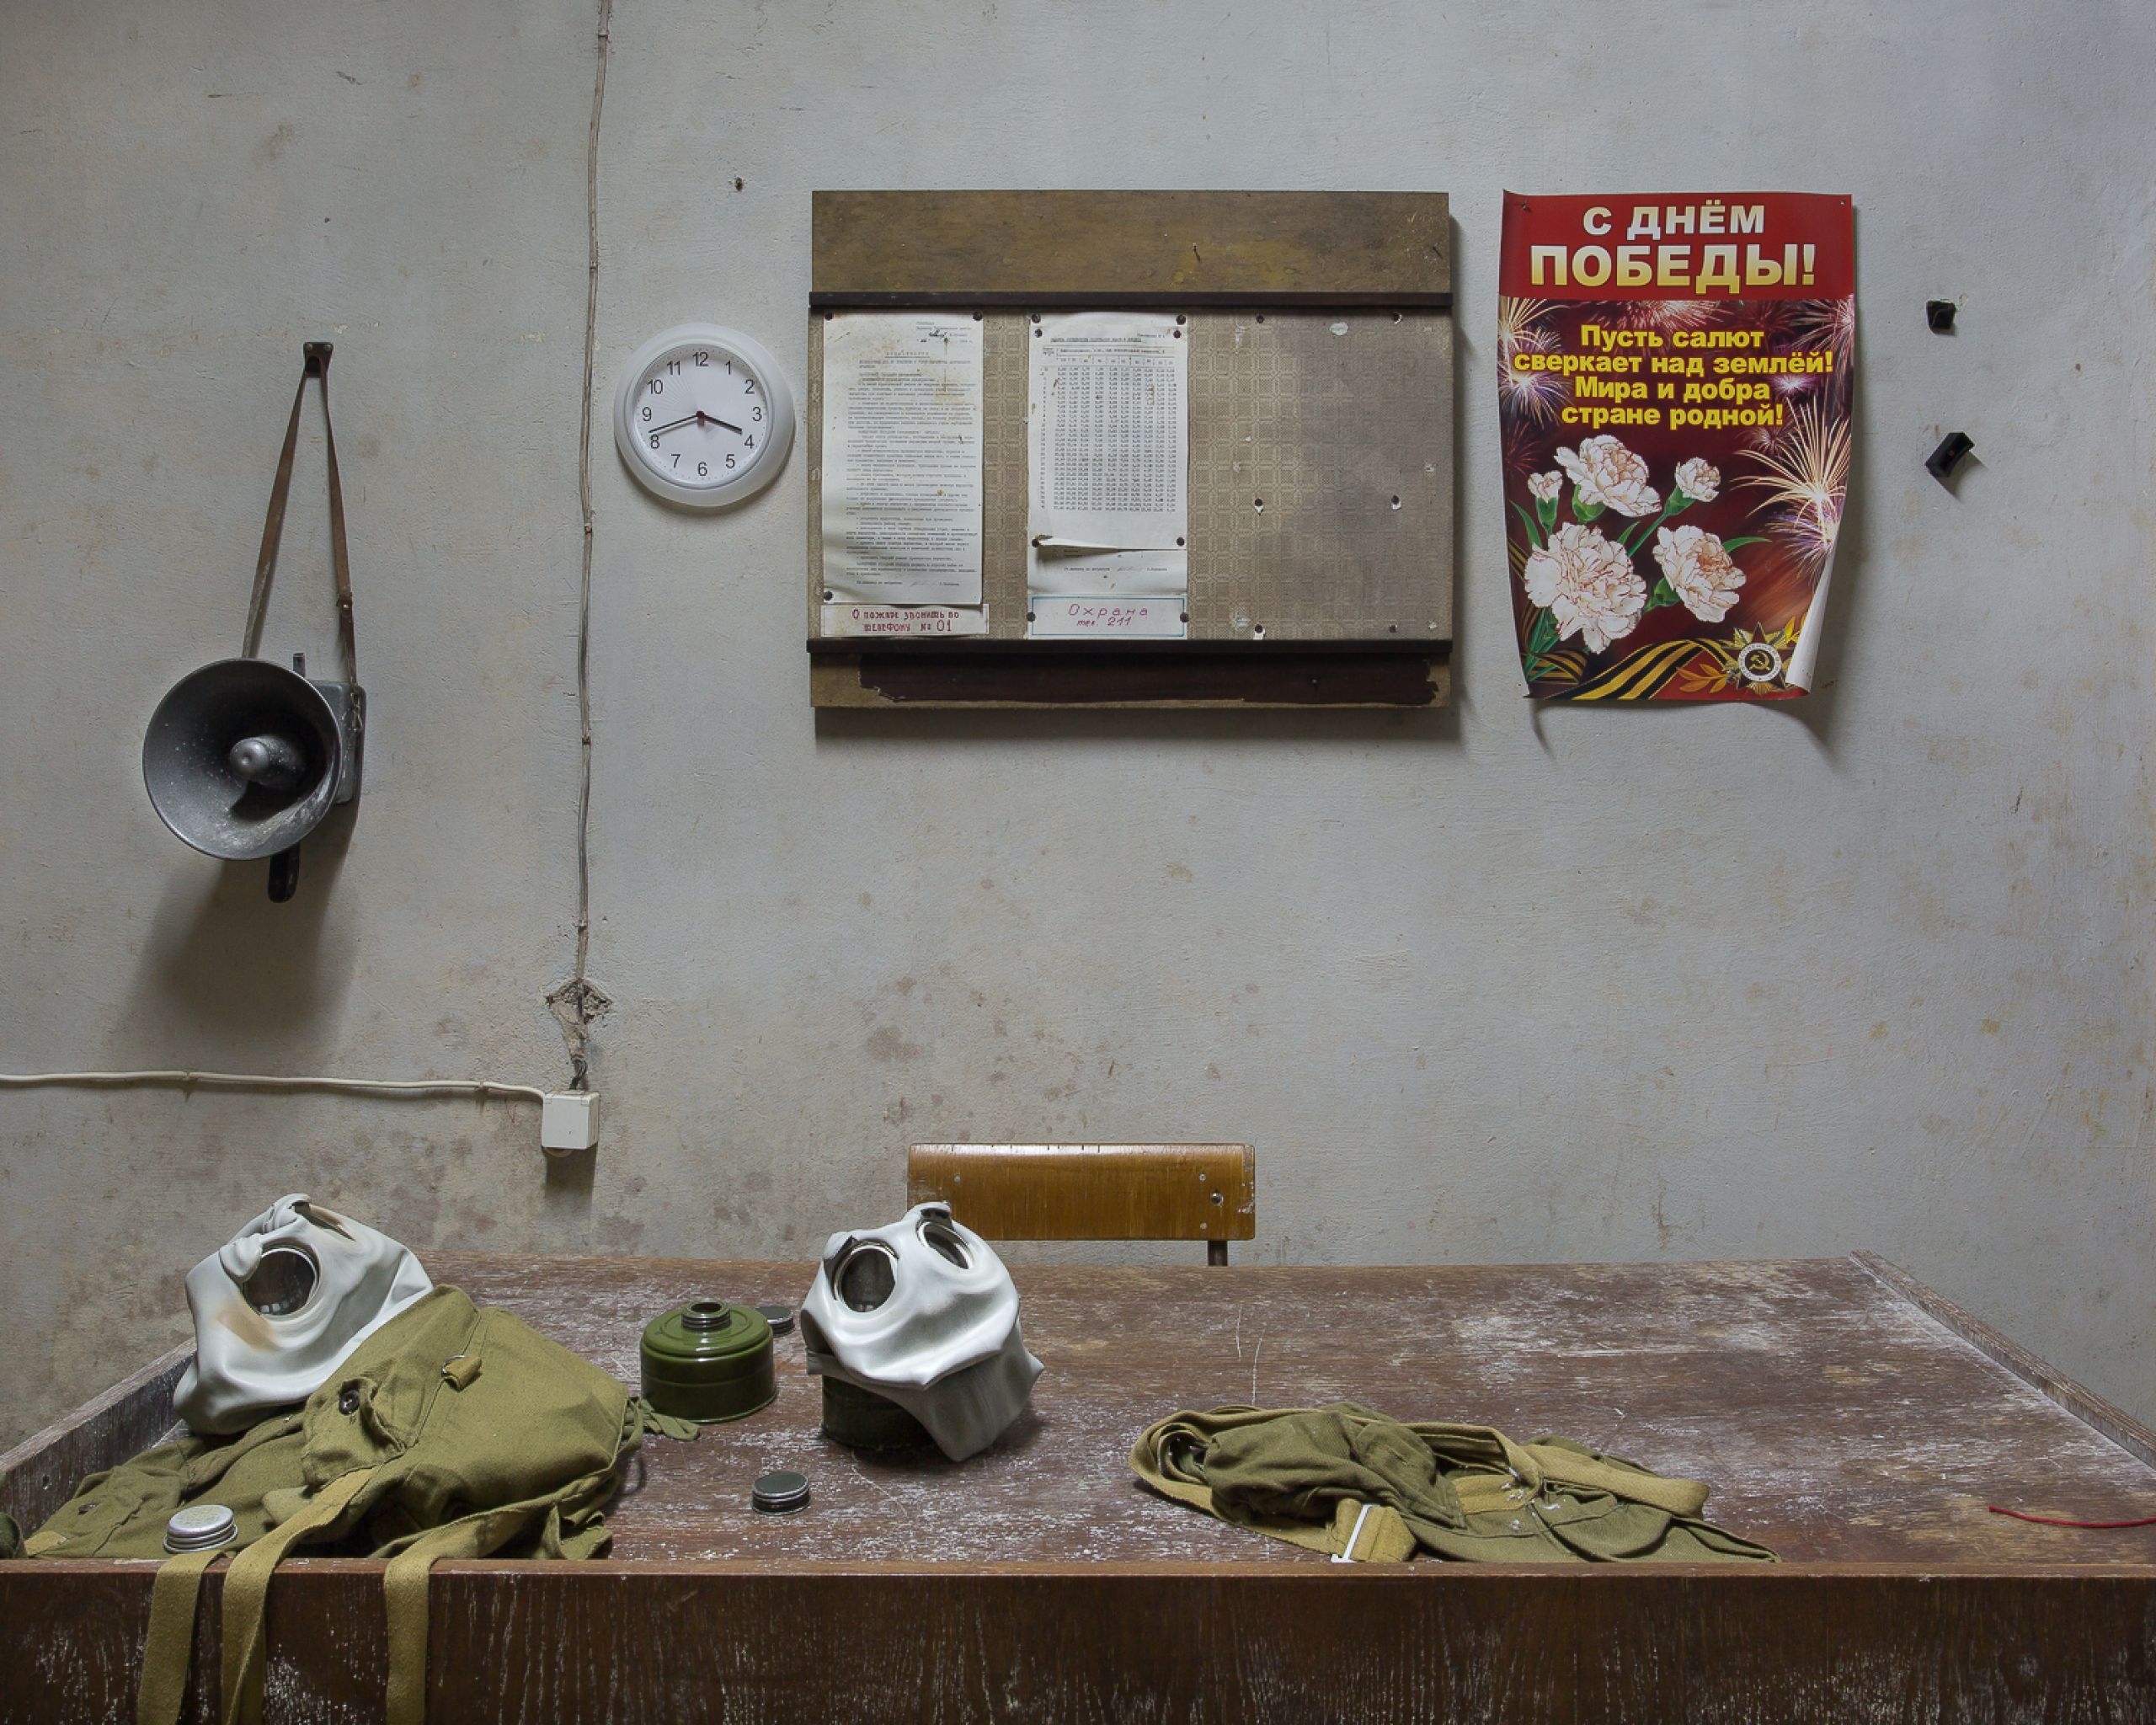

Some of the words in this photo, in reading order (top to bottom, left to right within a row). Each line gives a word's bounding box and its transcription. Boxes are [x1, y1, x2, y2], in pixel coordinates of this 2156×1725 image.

[1582, 206, 1612, 236] С
[1626, 199, 1765, 241] ДНЁМ
[1529, 243, 1817, 296] ПОБЕДЫ!
[1580, 324, 1664, 353] Пусть
[1672, 328, 1765, 350] салют
[692, 351, 709, 367] 12
[1514, 354, 1642, 377] сверкает
[1652, 356, 1705, 377] над
[1713, 351, 1833, 374] землёй!
[666, 360, 681, 376] 11
[725, 360, 732, 375] 1
[647, 379, 664, 395] 10
[744, 379, 755, 394] 2
[1575, 376, 1649, 404] Мира
[1657, 382, 1674, 400] и
[1683, 378, 1770, 403] добра
[642, 406, 652, 422] 9
[752, 406, 762, 422] 3
[1561, 408, 1662, 430] стране
[1669, 403, 1784, 430] родной!
[649, 434, 660, 450] 8
[744, 434, 755, 449] 4
[670, 453, 681, 468] 7
[725, 453, 735, 469] 5
[697, 461, 707, 477] 6
[851, 608, 860, 620] О
[863, 611, 900, 619] пожаре
[904, 611, 945, 621] звонить
[947, 611, 960, 619] по
[1068, 603, 1149, 619] Охрана
[863, 622, 910, 632] телефону
[937, 620, 953, 631] 01
[1107, 616, 1132, 627] 211
